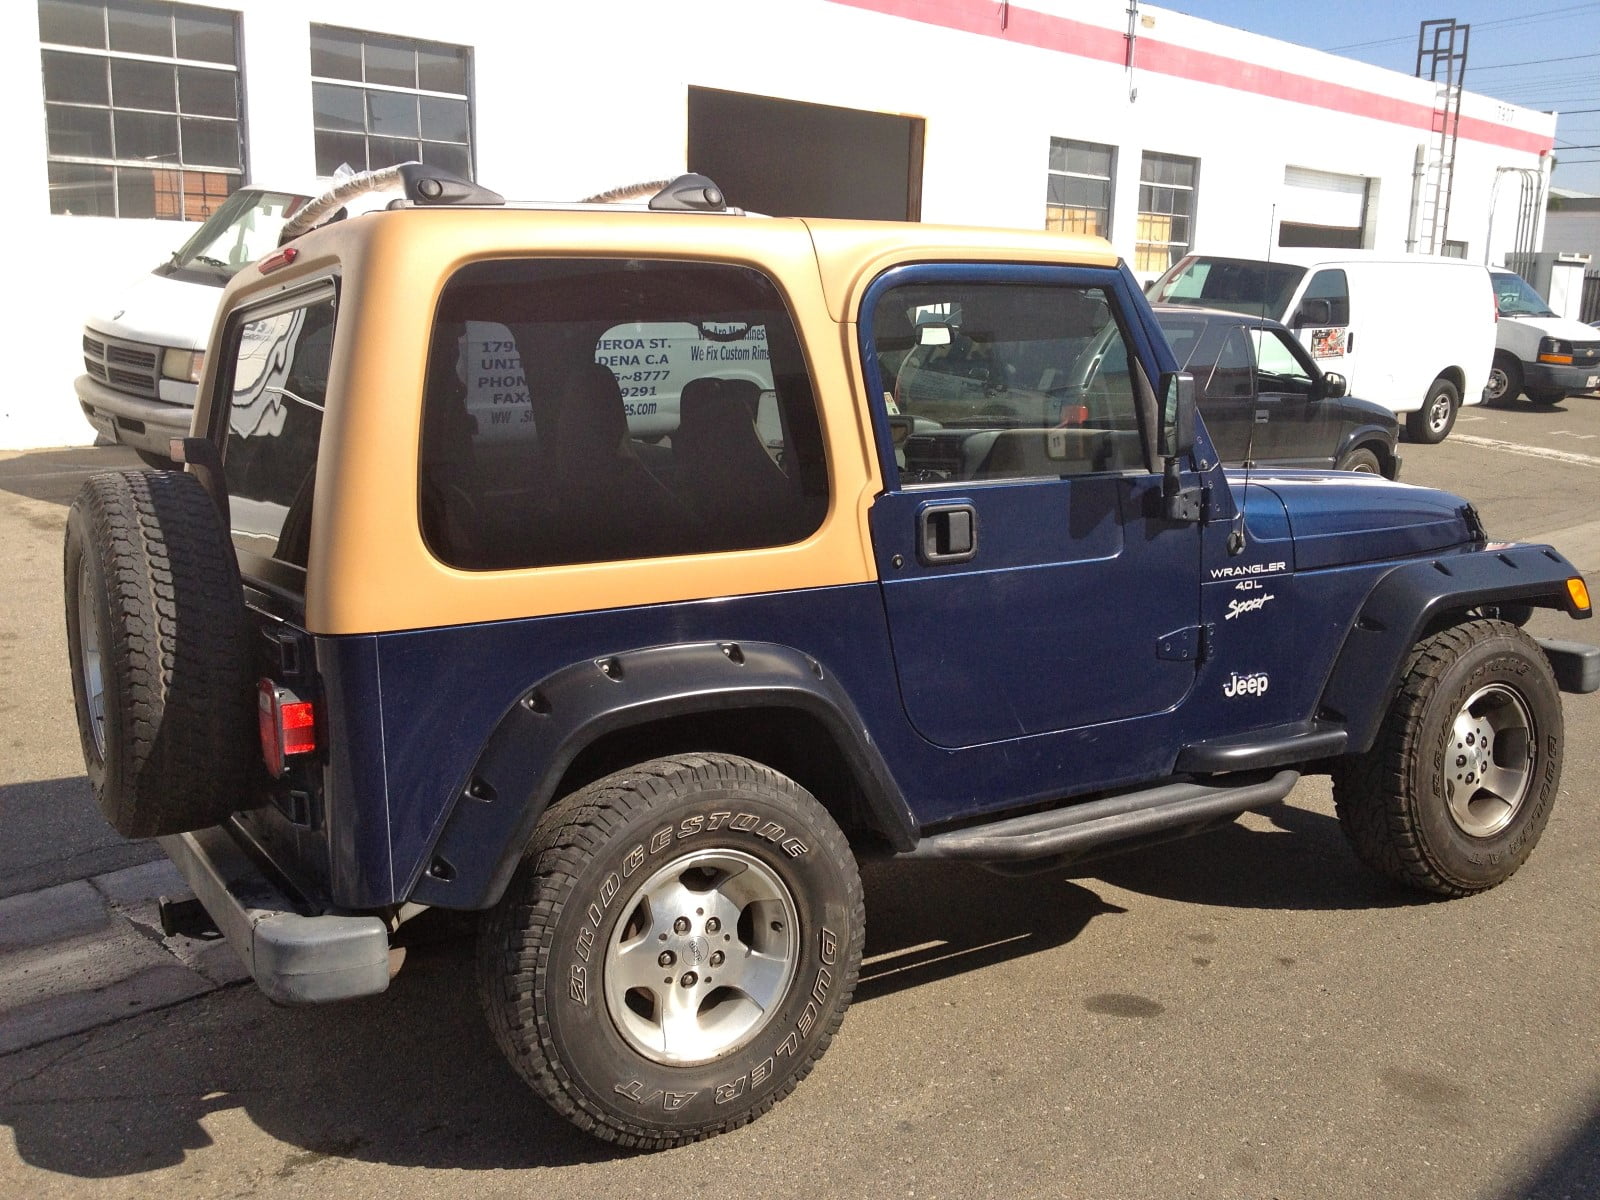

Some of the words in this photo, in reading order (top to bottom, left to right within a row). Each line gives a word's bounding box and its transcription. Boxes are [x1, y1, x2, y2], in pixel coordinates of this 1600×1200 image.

[649, 338, 671, 349] ST.
[690, 345, 705, 361] We
[706, 345, 718, 361] Fix
[720, 344, 750, 361] Custom
[645, 354, 669, 365] C.A
[1210, 561, 1286, 579] WRANGLER
[1224, 593, 1275, 621] Sport
[1223, 672, 1269, 697] Jeep
[569, 811, 809, 1006] BRIDGESTONE
[714, 926, 838, 1106] DUELER
